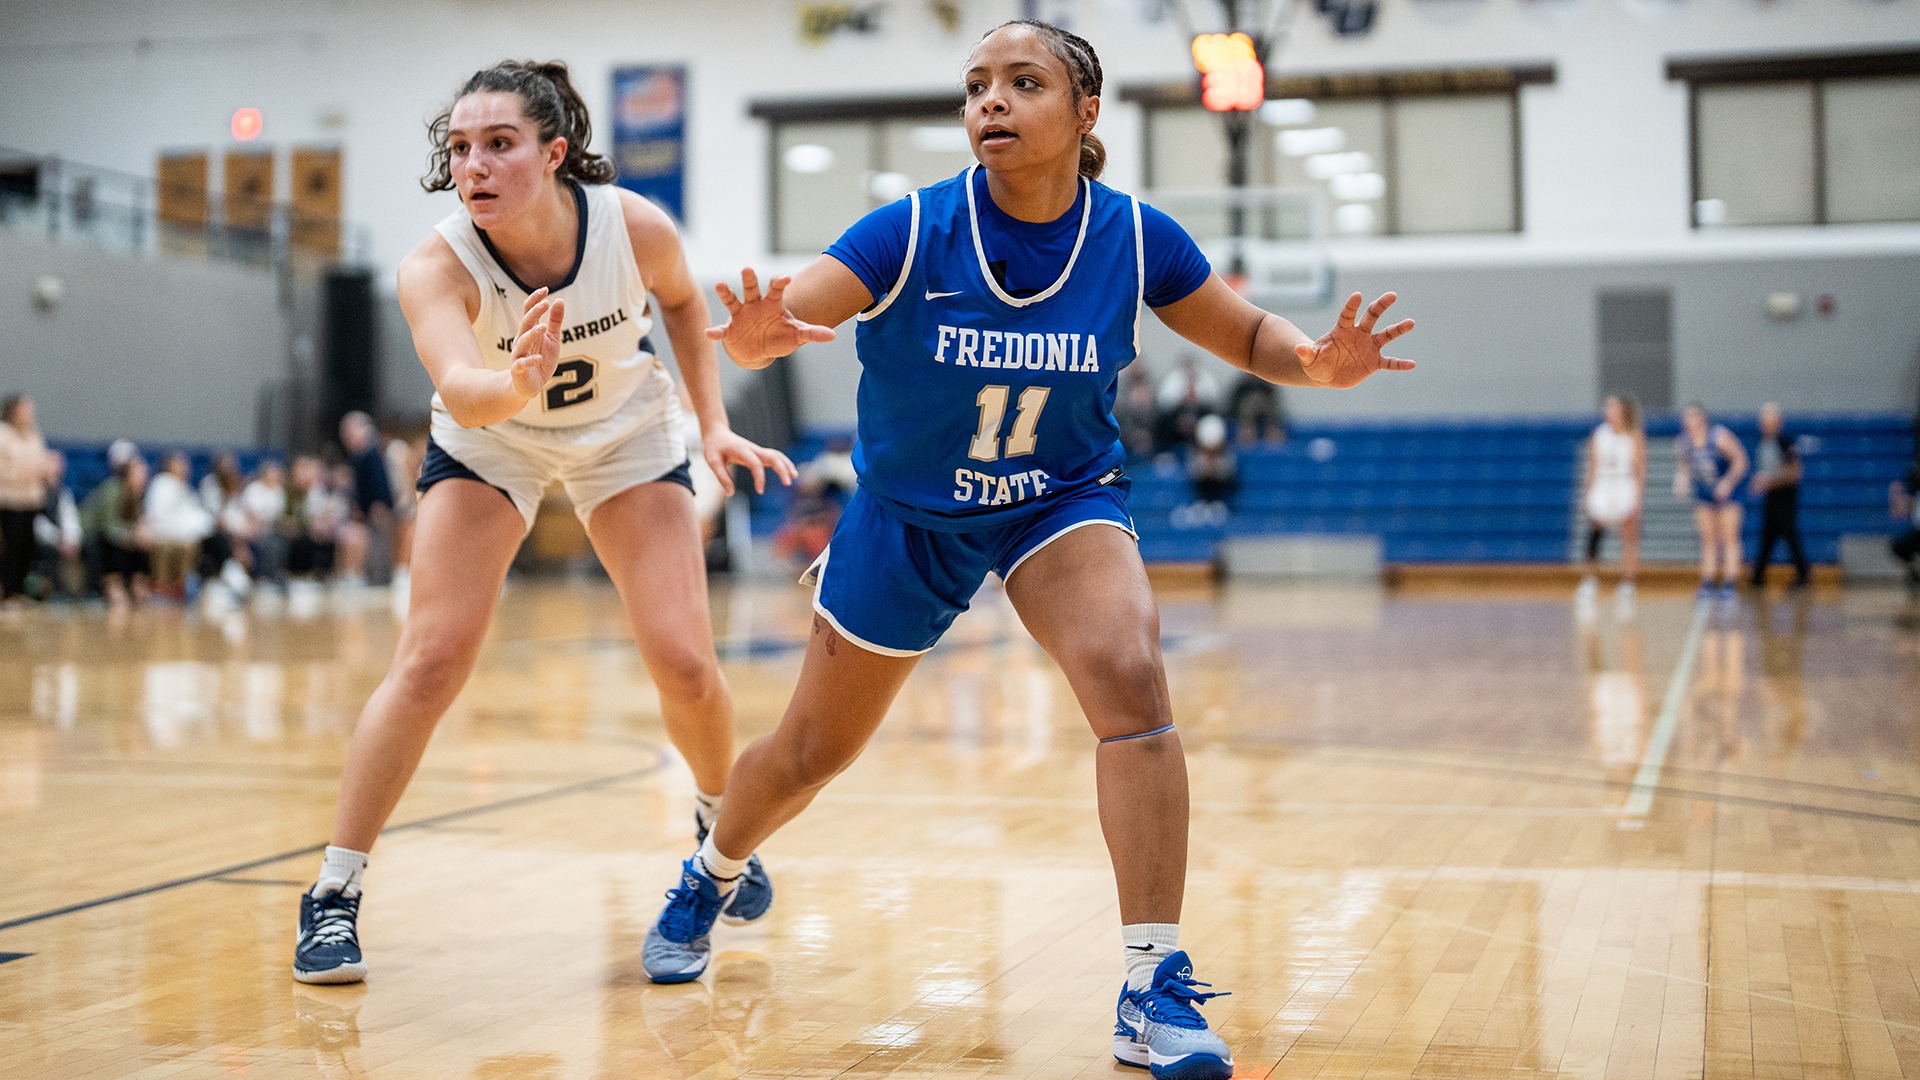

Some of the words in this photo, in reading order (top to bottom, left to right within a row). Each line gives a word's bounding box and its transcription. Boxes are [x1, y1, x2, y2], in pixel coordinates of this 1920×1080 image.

[561, 308, 628, 344] ARROLL
[934, 324, 1100, 373] FREDONIA
[541, 354, 599, 413] 2
[968, 384, 1052, 463] 11
